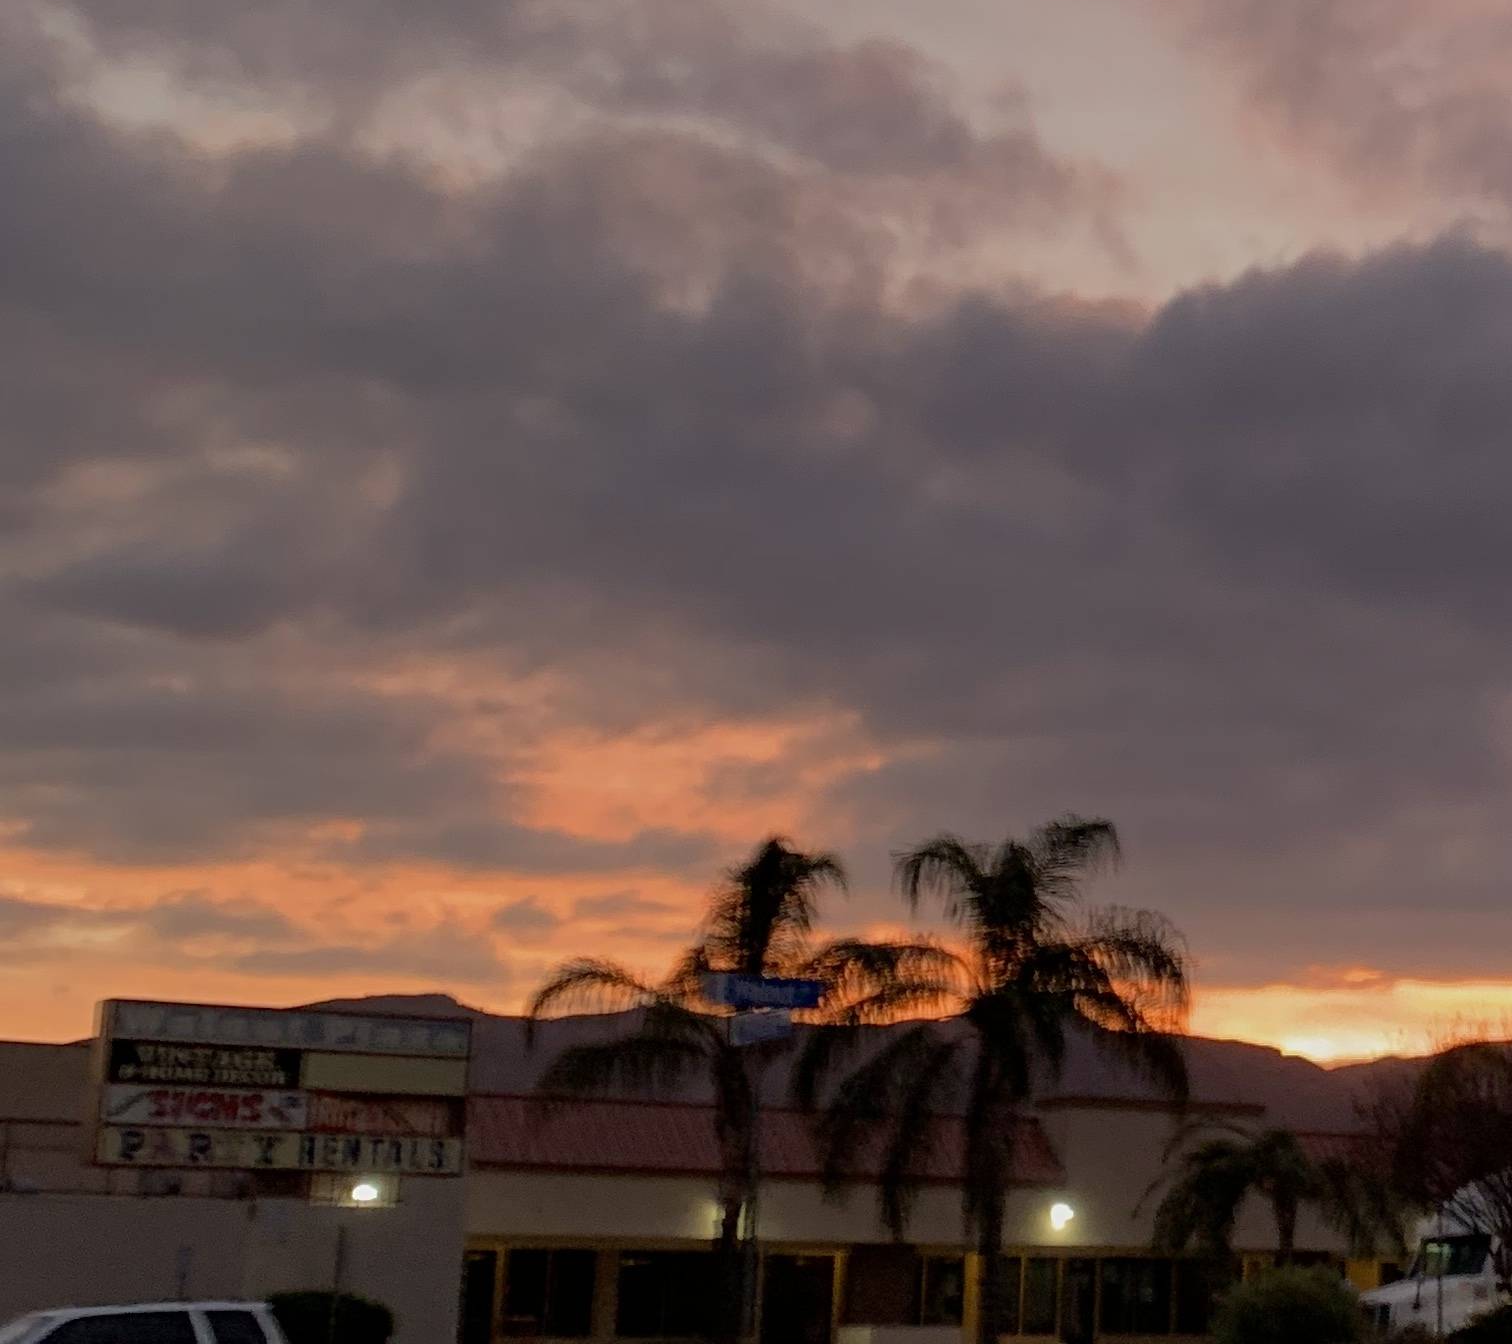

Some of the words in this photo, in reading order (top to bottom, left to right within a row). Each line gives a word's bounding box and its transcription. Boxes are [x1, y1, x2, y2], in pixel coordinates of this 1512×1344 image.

[147, 1089, 265, 1121] SIGNS
[120, 1129, 282, 1167] PARTY
[298, 1133, 447, 1170] RENTALS
